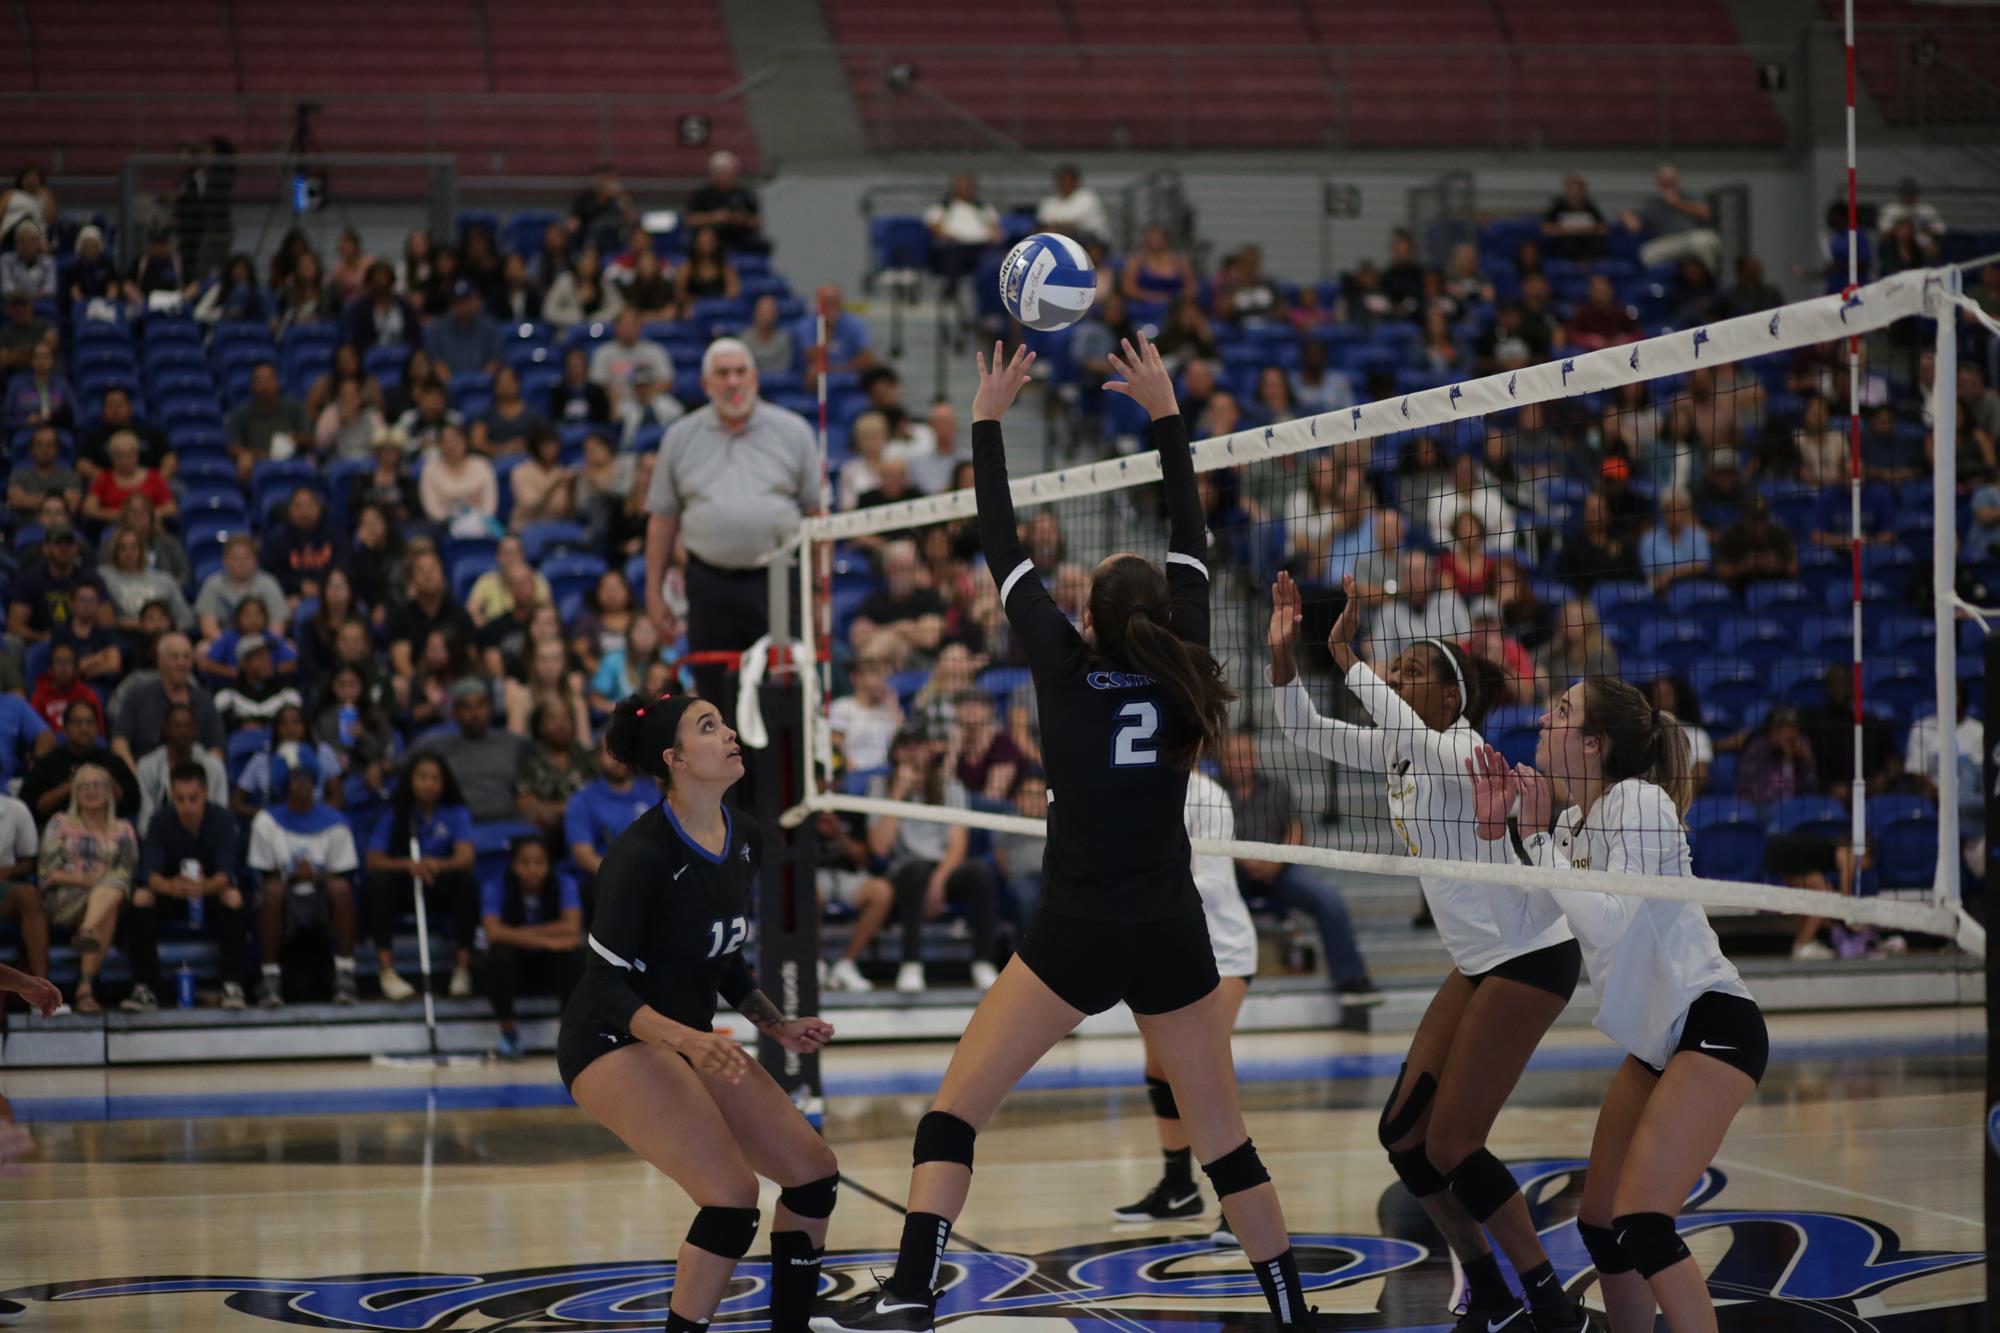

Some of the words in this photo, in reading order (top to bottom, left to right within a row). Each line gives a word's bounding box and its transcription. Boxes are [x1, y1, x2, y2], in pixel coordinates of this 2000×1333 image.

[1000, 247, 1021, 300] molten
[1007, 254, 1029, 304] NCAA
[1112, 700, 1160, 767] 2
[707, 916, 747, 958] 12
